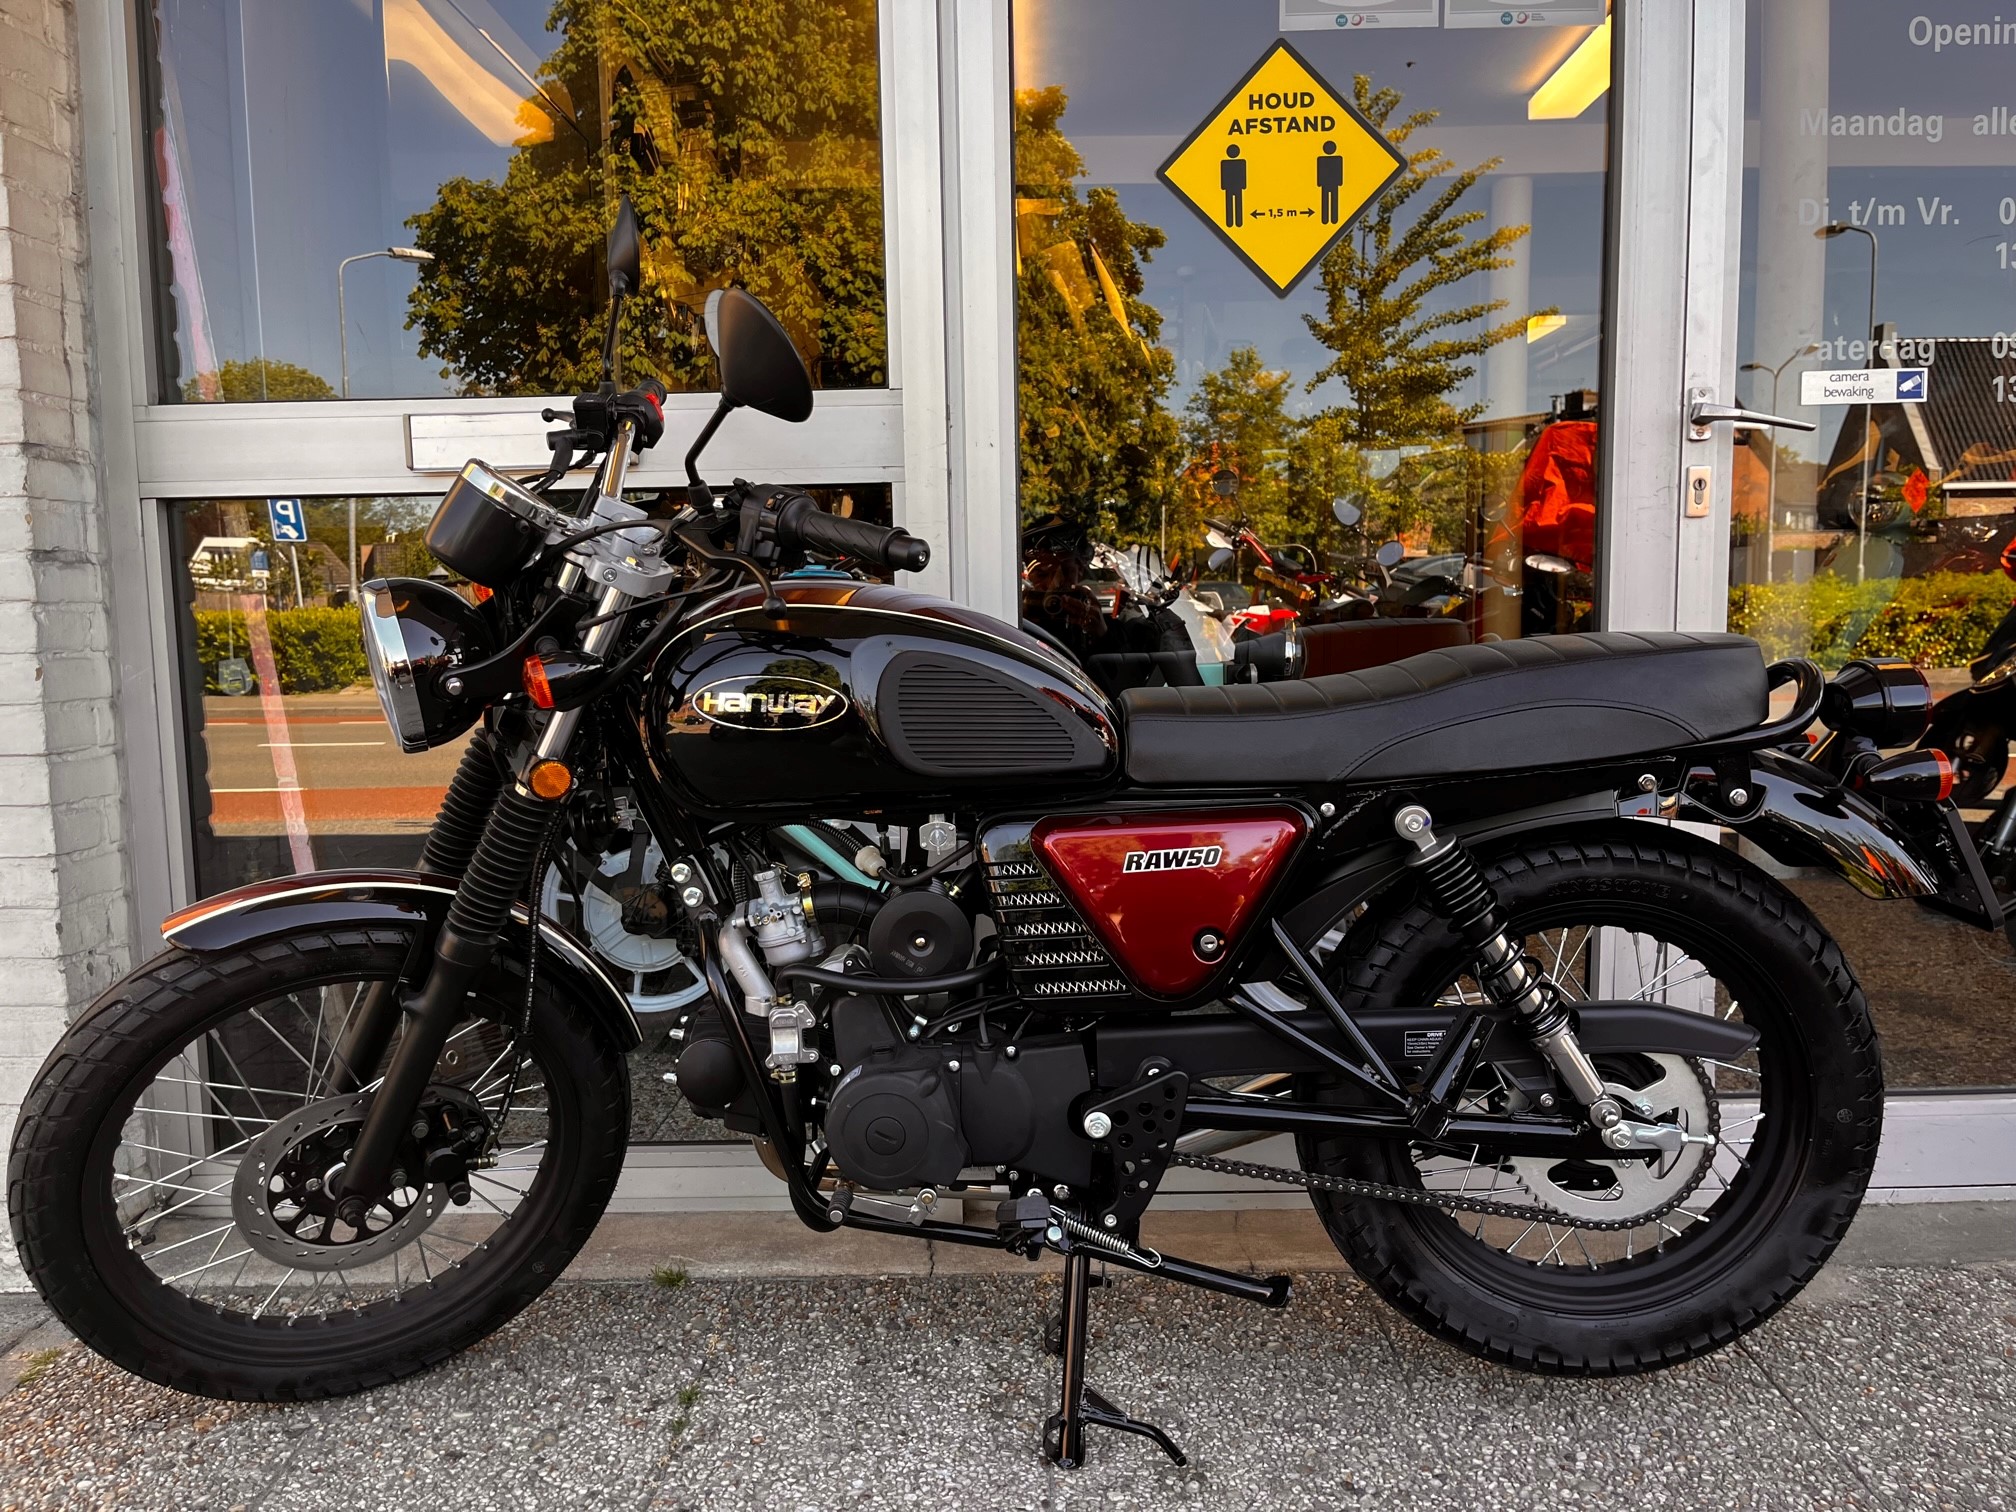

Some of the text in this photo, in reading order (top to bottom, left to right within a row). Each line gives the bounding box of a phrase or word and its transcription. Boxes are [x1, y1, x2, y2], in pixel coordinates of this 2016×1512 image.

[1908, 15, 2016, 53] Openin
[1248, 91, 1316, 111] HOUD
[1227, 115, 1336, 136] AFSTAND
[1799, 106, 1944, 144] Maandag
[1268, 208, 1297, 219] 1,5 m
[1799, 198, 1838, 226] Di.
[1848, 197, 1906, 226] t/m
[1916, 196, 1960, 226] Vr.
[1798, 331, 1936, 367] Zaterdag
[1829, 372, 1870, 383] camera
[1823, 385, 1875, 399] bewaking
[1122, 845, 1223, 874] RAW50
